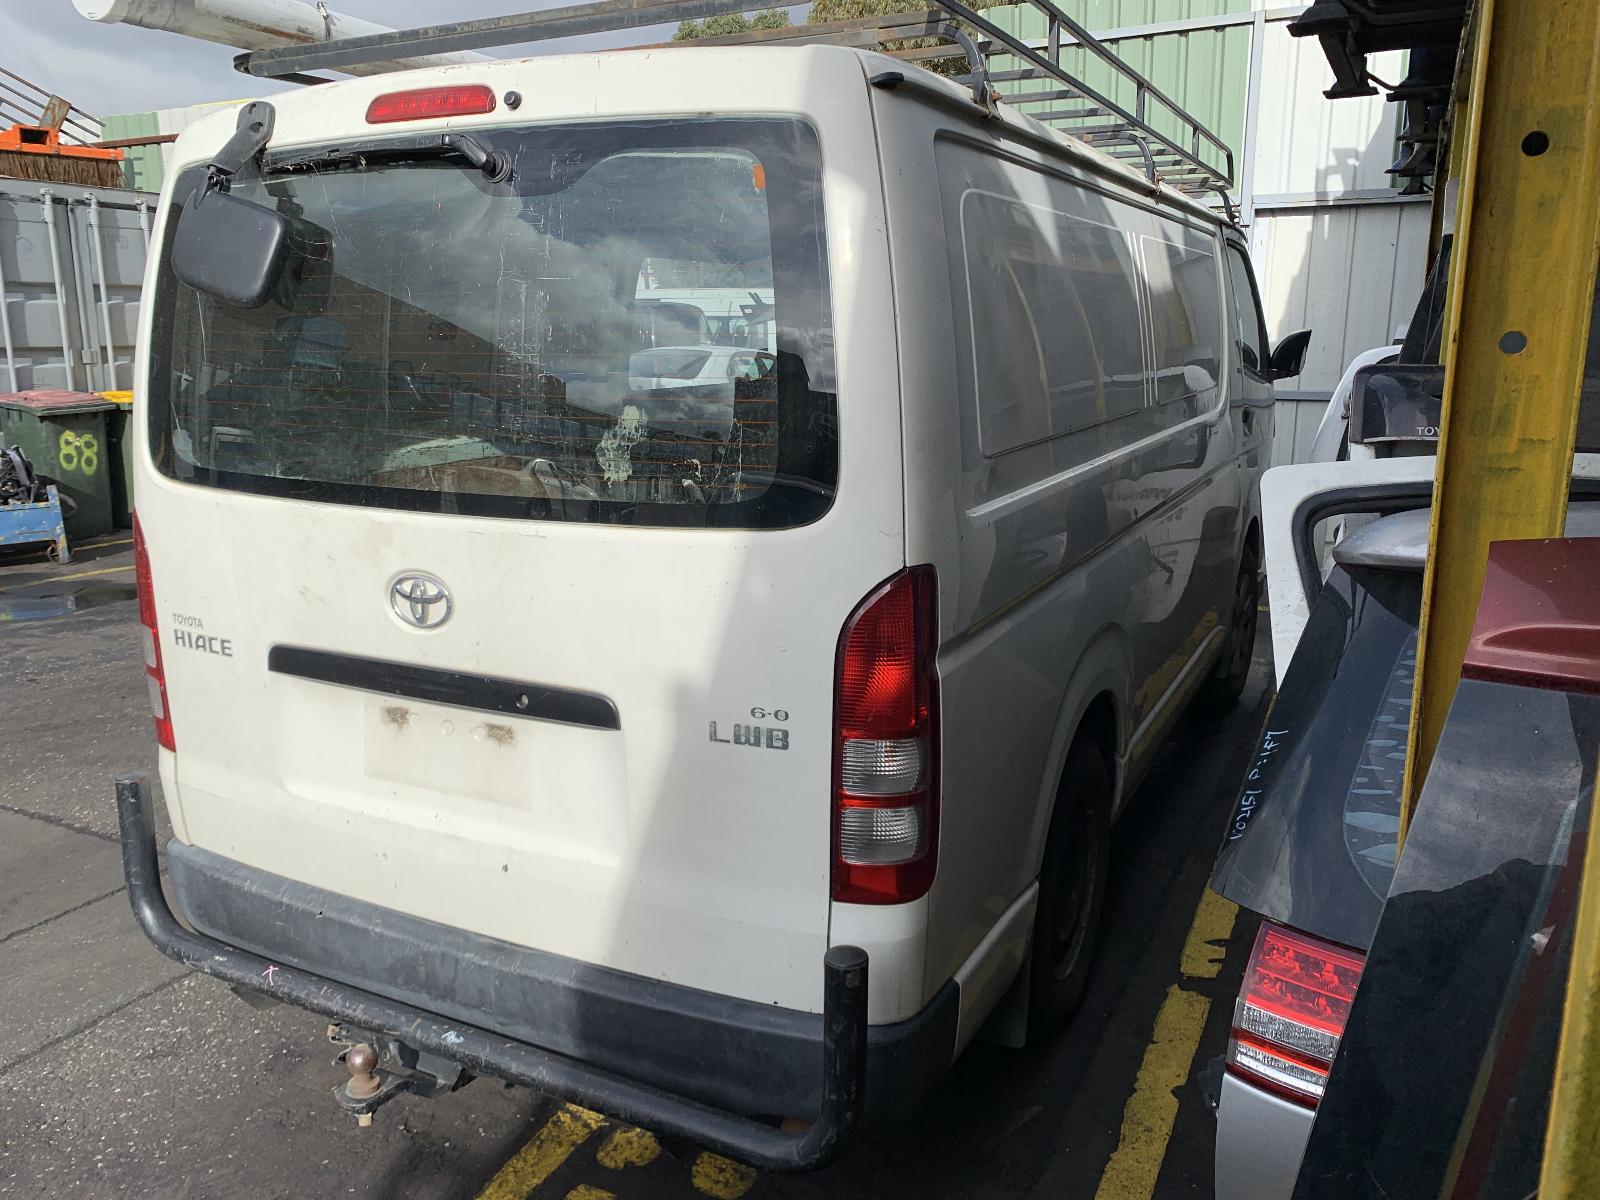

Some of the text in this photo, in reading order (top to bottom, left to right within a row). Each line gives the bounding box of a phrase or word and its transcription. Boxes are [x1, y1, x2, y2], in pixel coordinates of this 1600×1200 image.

[60, 430, 98, 477] 88
[172, 612, 204, 630] TOYOTA
[174, 628, 233, 657] HIACE
[709, 720, 789, 750] LWB
